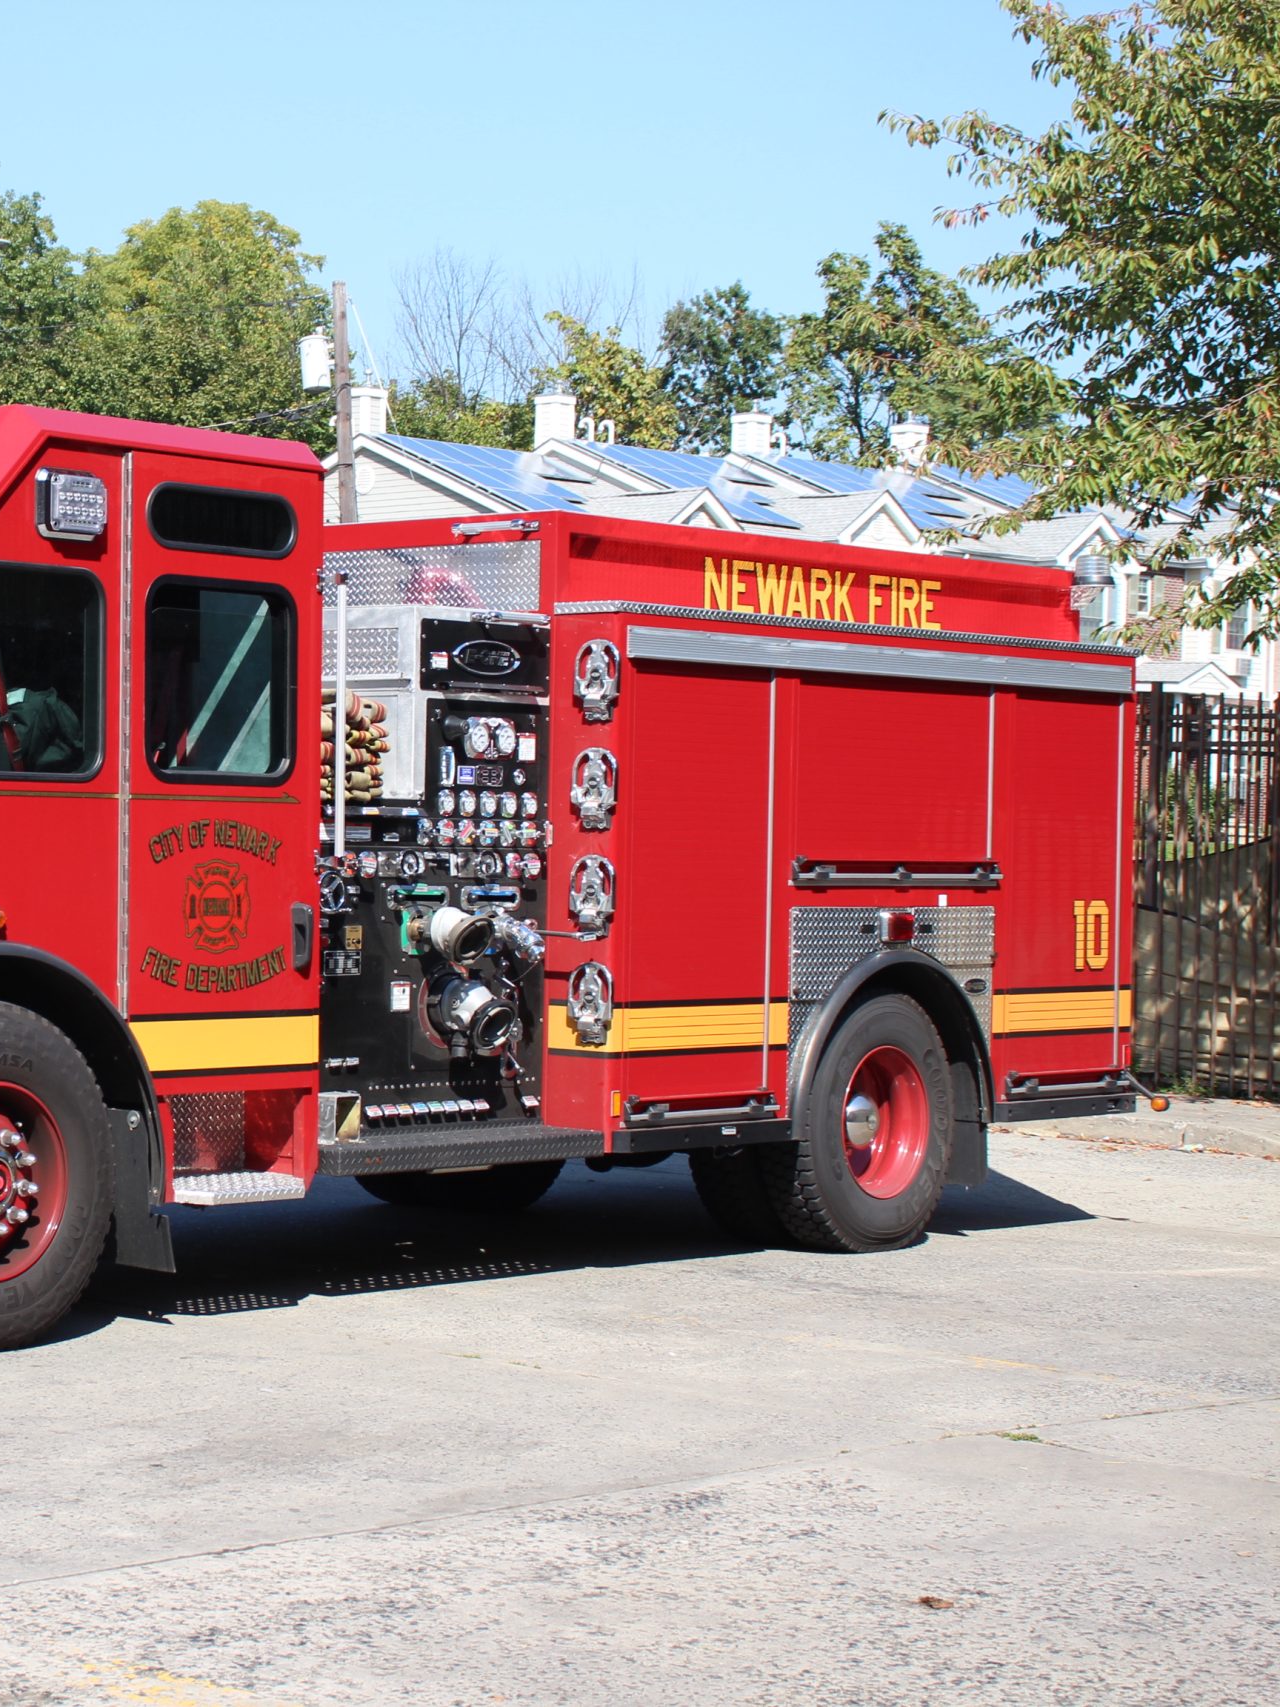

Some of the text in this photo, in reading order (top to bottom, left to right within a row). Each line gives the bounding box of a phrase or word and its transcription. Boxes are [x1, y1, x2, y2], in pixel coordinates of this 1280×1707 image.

[704, 556, 941, 631] NEWARK FIRE
[149, 819, 282, 865] CITY OF NEWARK
[1073, 900, 1110, 971] 10
[140, 946, 182, 987] FIRE
[185, 945, 287, 993] DEPARTMENT
